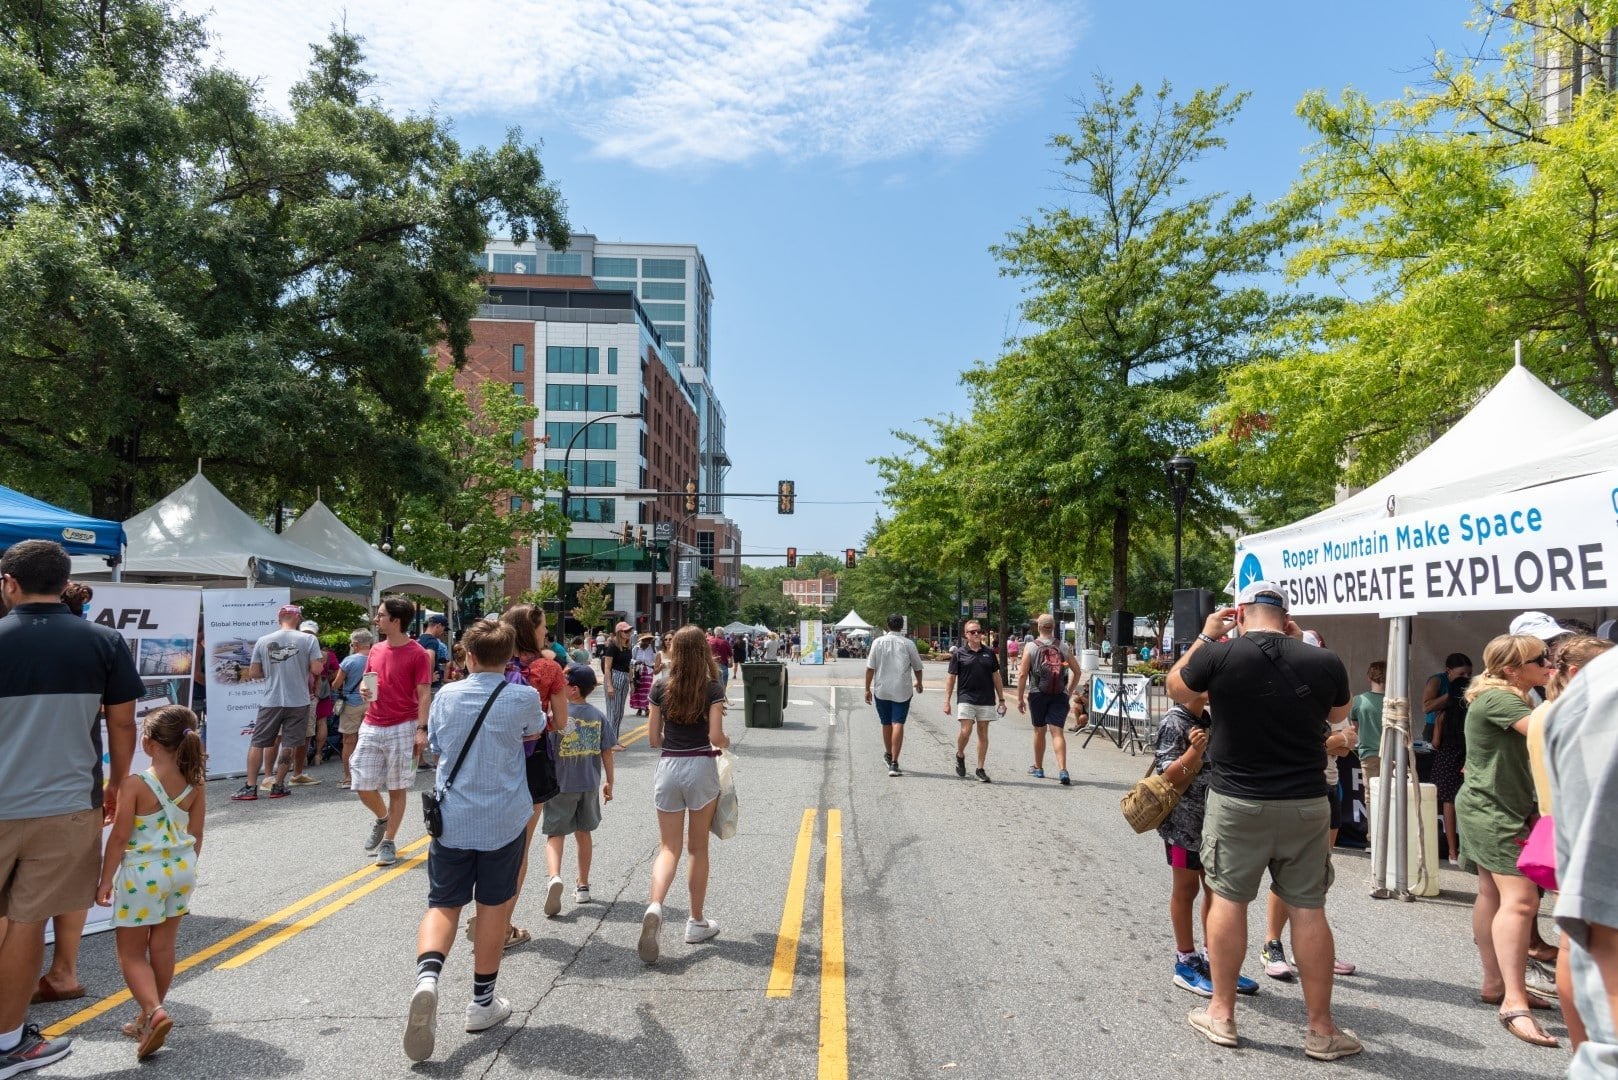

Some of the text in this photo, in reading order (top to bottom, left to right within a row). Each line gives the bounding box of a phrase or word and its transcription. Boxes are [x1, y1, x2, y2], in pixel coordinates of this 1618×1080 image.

[656, 523, 670, 532] AC
[1282, 507, 1542, 570] Roper Mountain Make Space
[291, 571, 351, 588] Lockheed Martin
[1271, 542, 1607, 606] ESIGN CREATE EXPLORE
[94, 608, 158, 630] AFL
